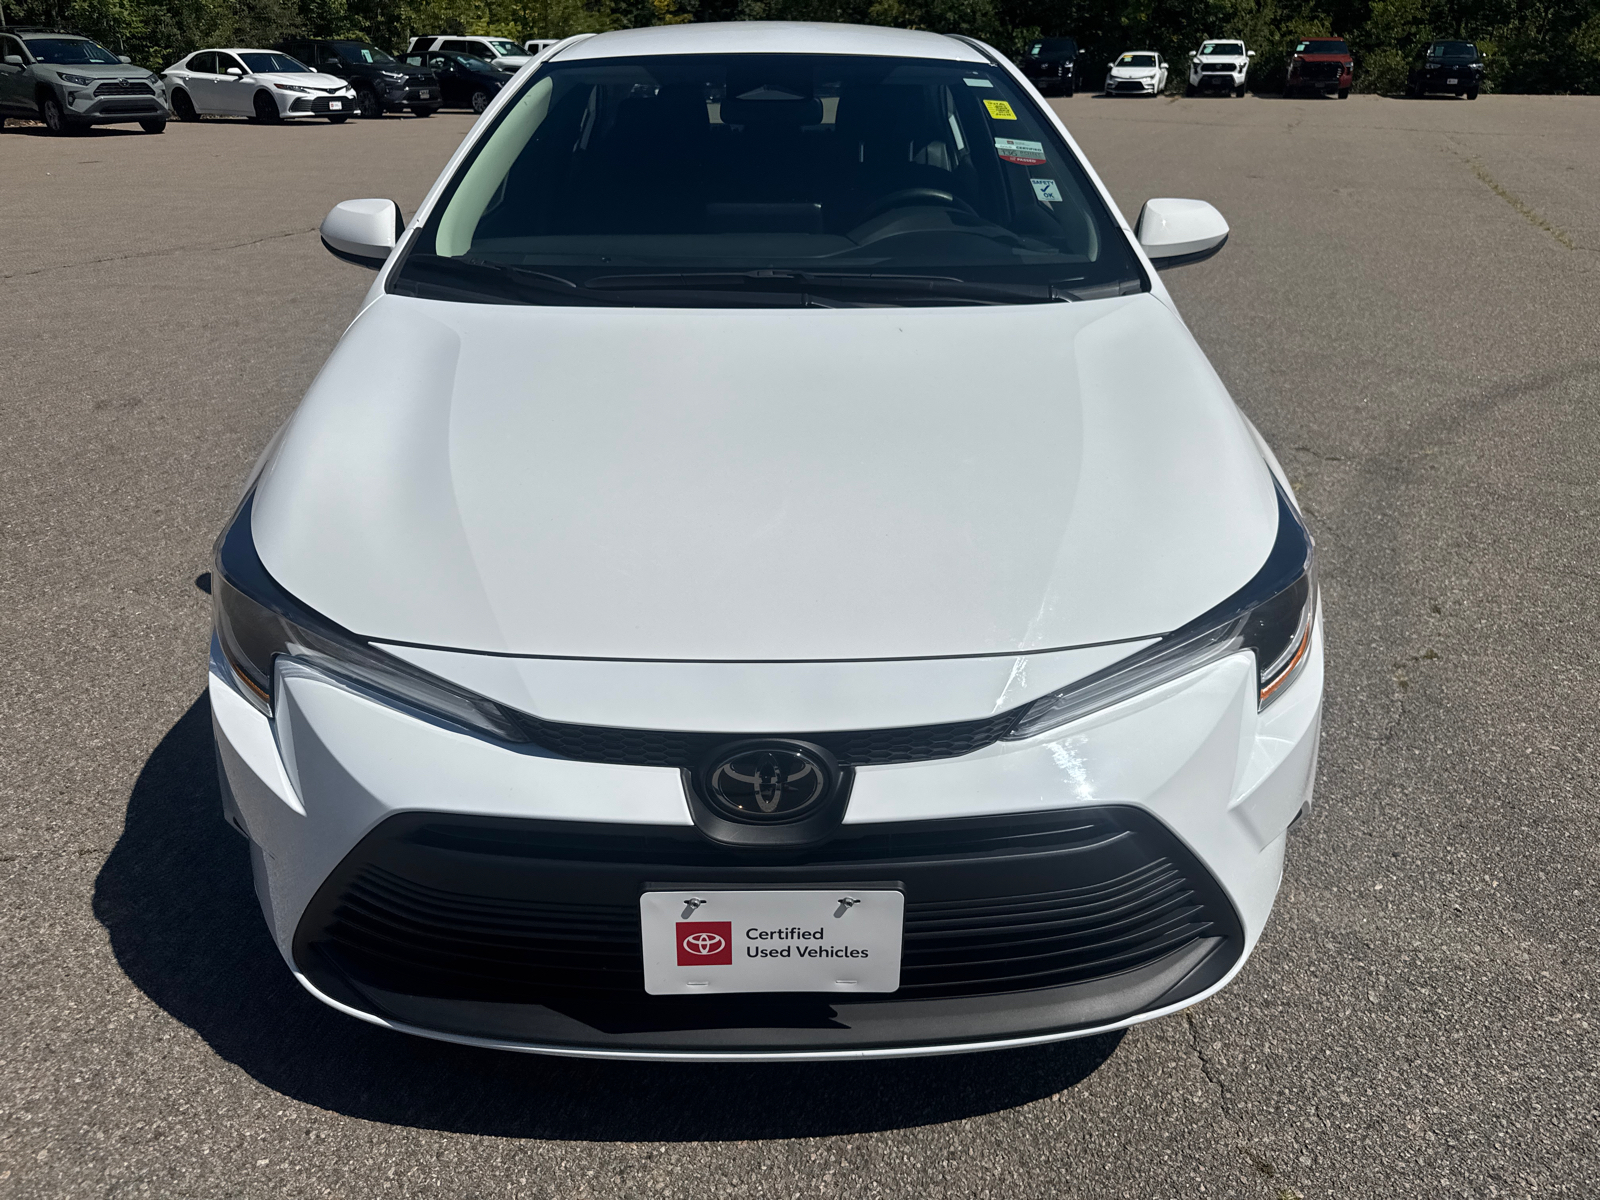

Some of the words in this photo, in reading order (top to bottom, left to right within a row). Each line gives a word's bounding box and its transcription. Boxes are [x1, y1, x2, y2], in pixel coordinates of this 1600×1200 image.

[745, 927, 824, 940] Certified
[746, 946, 791, 958] Used
[796, 945, 869, 958] Vehicles
